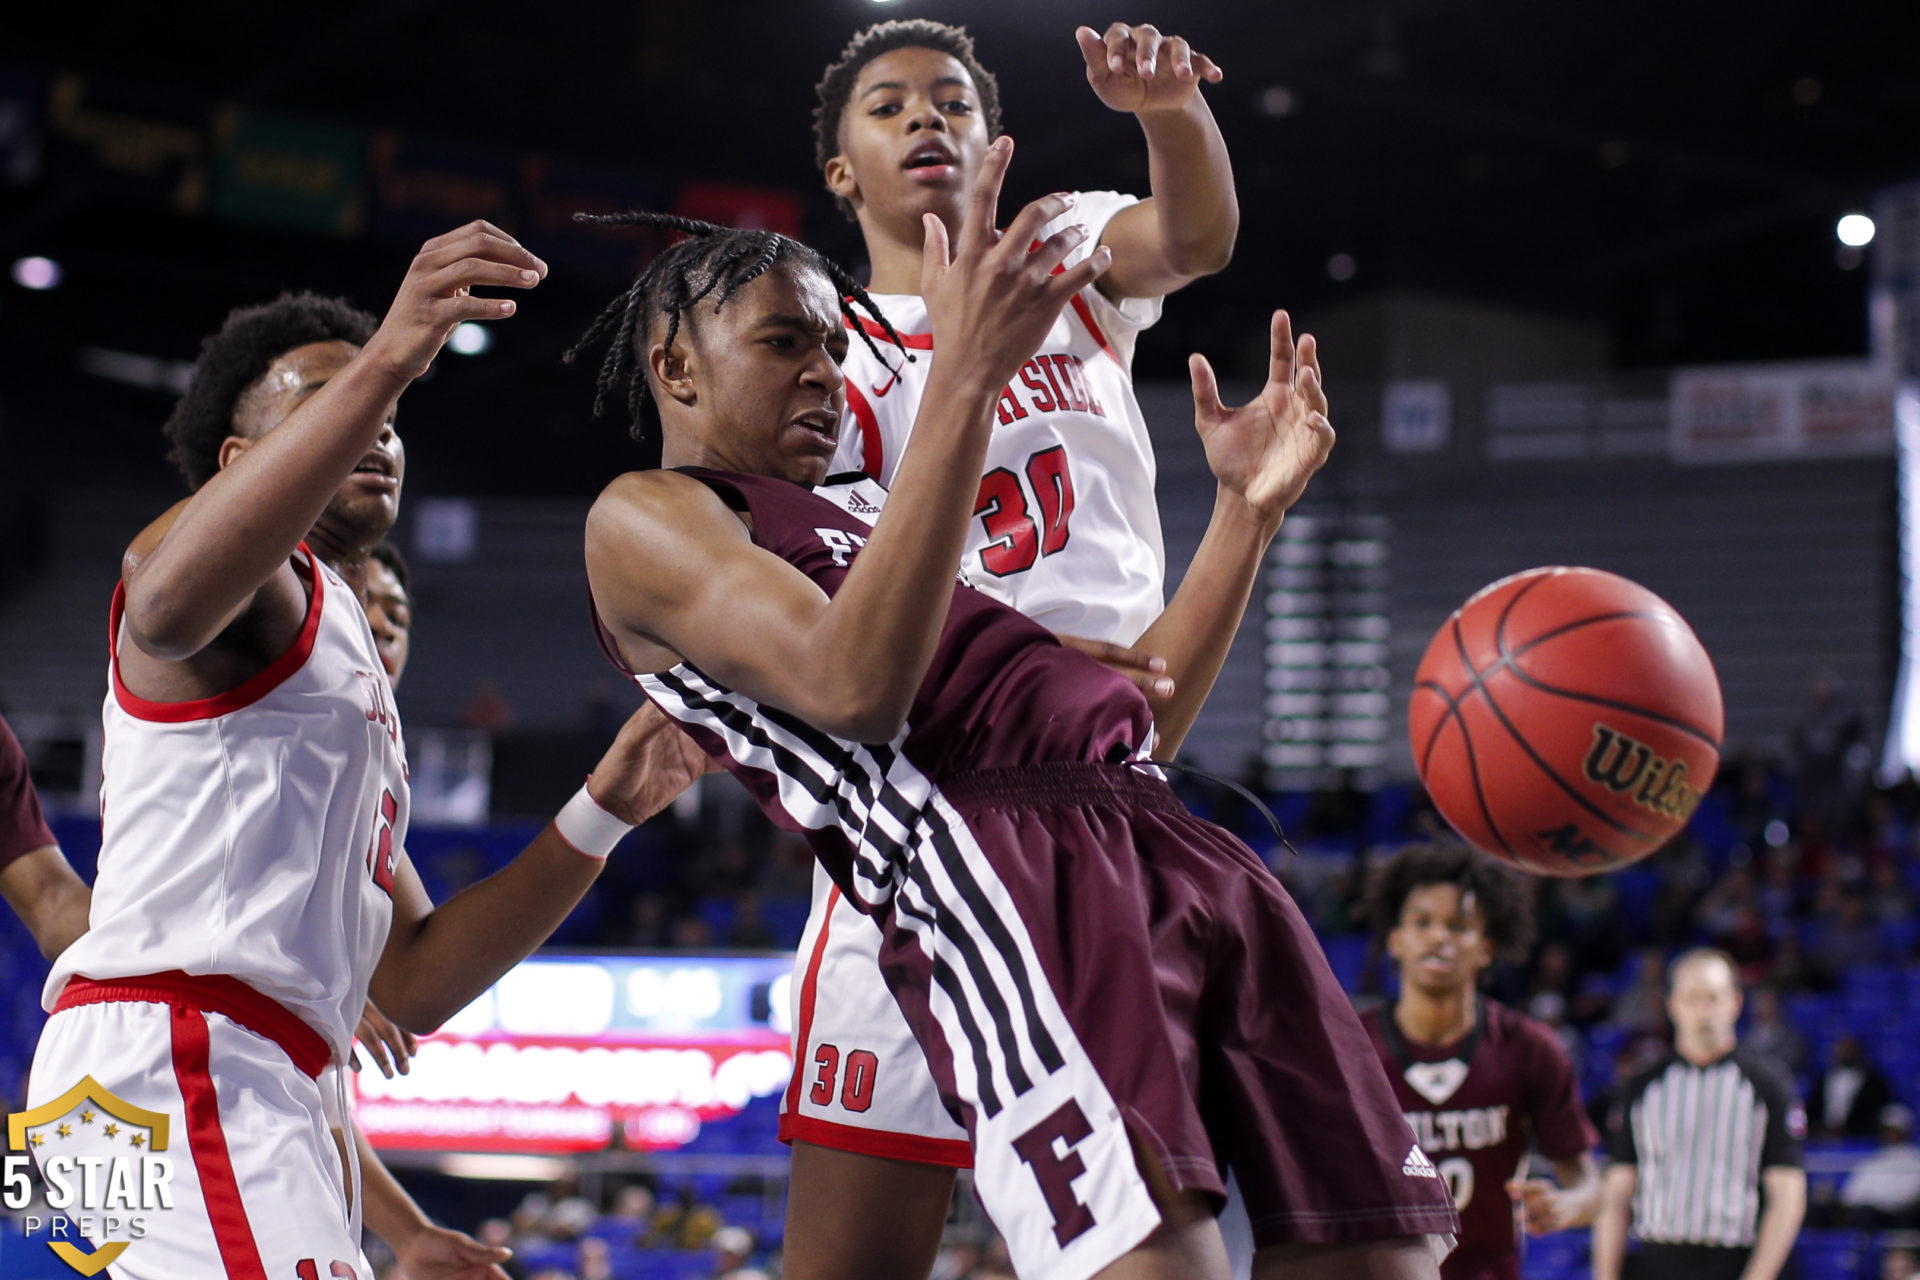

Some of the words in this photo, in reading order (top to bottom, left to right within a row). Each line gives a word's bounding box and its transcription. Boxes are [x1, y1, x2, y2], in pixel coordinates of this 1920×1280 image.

[972, 444, 1075, 578] 30
[1584, 721, 1704, 819] Wils
[810, 1043, 878, 1113] 30
[1010, 1096, 1095, 1251] F
[1403, 1106, 1509, 1151] LTON
